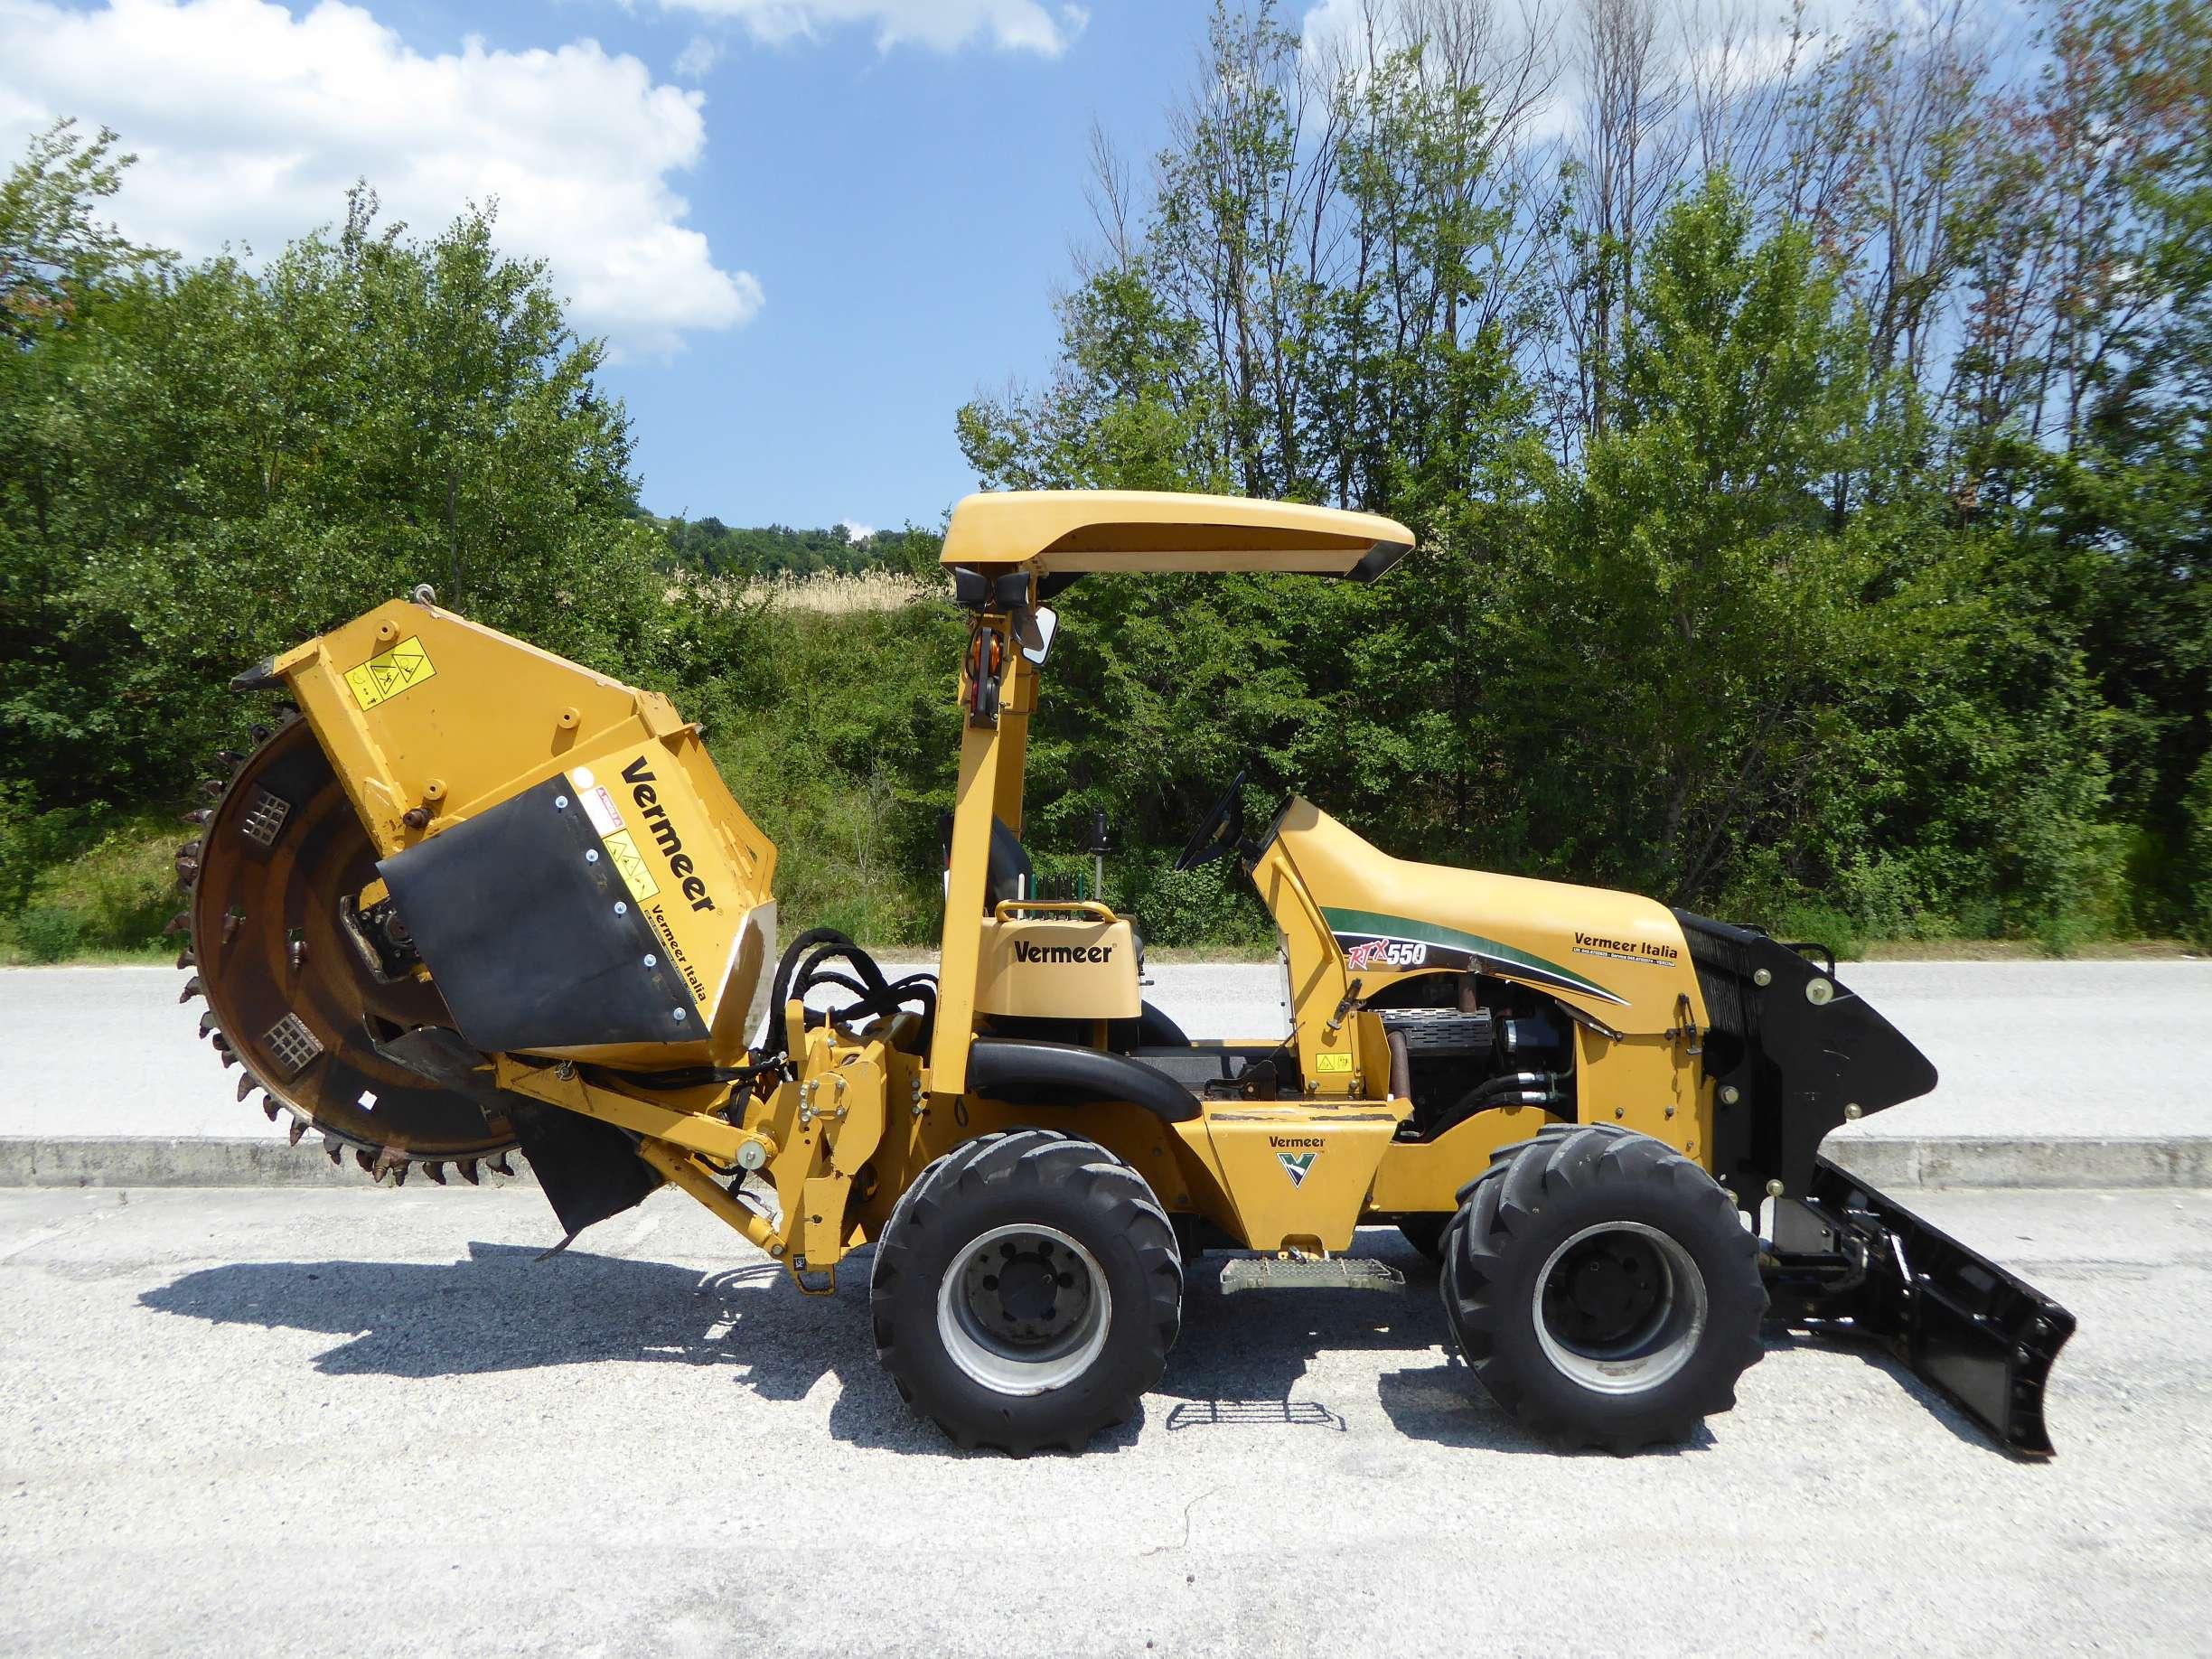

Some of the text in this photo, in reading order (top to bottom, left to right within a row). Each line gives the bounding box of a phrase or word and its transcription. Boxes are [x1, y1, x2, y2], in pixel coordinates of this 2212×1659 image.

[621, 755, 716, 912] Vermeer
[652, 904, 687, 963] Vermeer
[684, 965, 707, 1002] Italia
[1014, 941, 1112, 963] Vermeer
[1575, 932, 1636, 952] Vermeer
[1641, 942, 1678, 959] Italia
[1269, 1136, 1326, 1148] Vermeer
